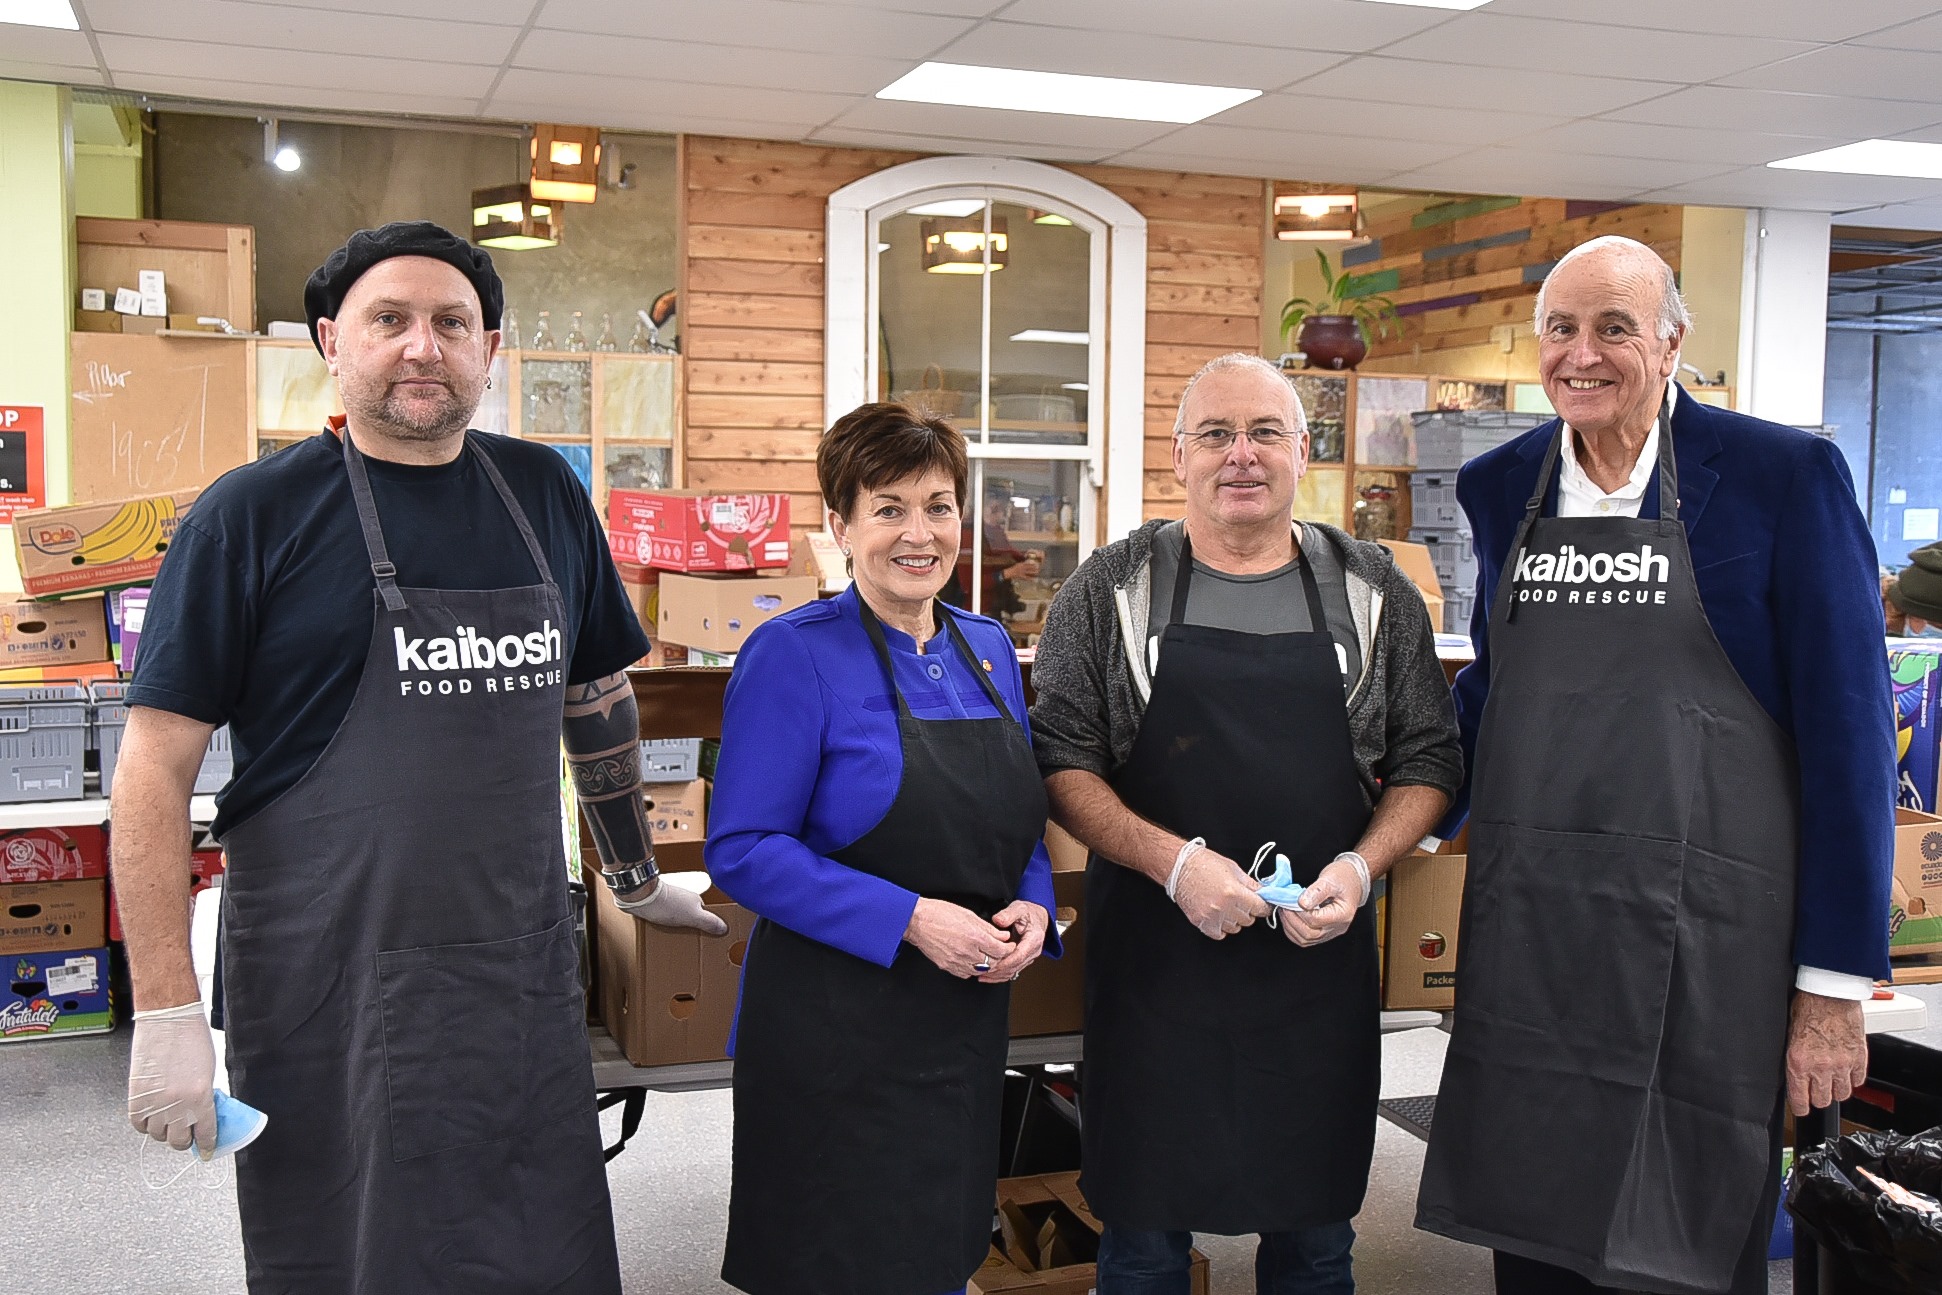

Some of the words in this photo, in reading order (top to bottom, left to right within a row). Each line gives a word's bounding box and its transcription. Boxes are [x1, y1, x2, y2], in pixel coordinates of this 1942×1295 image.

[39, 528, 76, 544] Dole
[1512, 544, 1670, 584] kaibosh
[1568, 589, 1667, 605] RESCUE
[393, 619, 561, 672] kaibosh
[400, 678, 472, 696] FOOD
[485, 669, 562, 693] RESCUE
